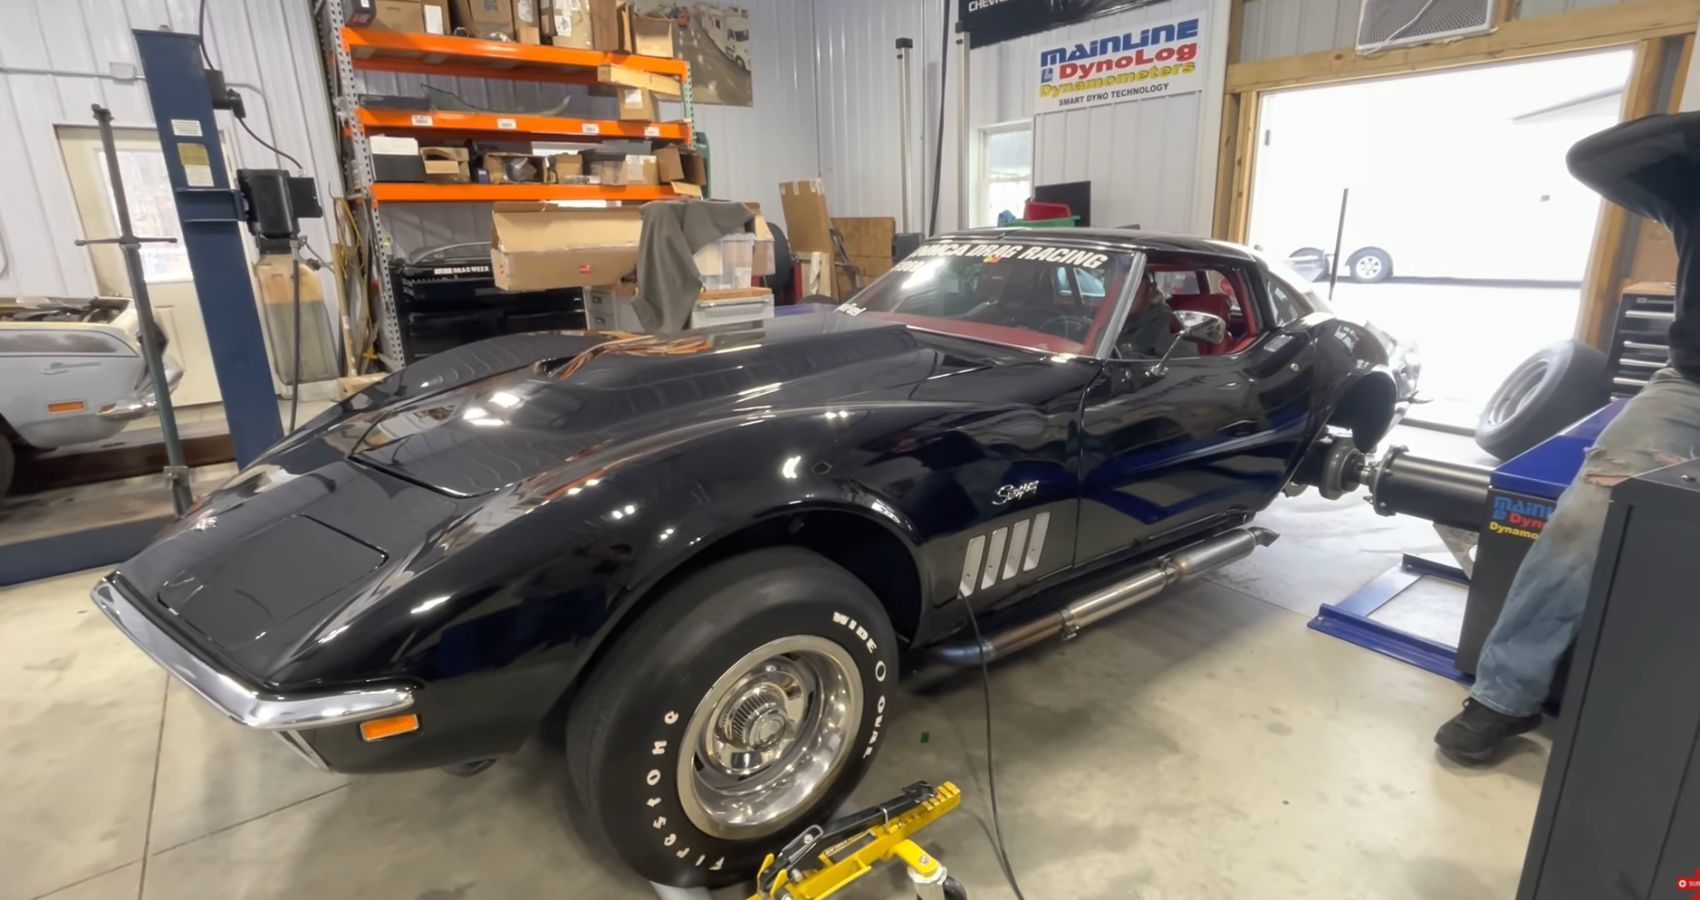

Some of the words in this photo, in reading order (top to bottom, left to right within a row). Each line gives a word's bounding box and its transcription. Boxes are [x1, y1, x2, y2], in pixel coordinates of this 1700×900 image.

[1039, 61, 1196, 97] Dynamometers
[1059, 42, 1198, 80] DynoLog
[1058, 95, 1085, 107] SMART
[1086, 91, 1109, 102] DYNO
[1111, 82, 1170, 98] TECHNOLOGY
[964, 244, 1024, 259] DRAG
[1017, 246, 1109, 269] RACING
[832, 611, 878, 653] WIDE
[863, 695, 886, 759] OVAL
